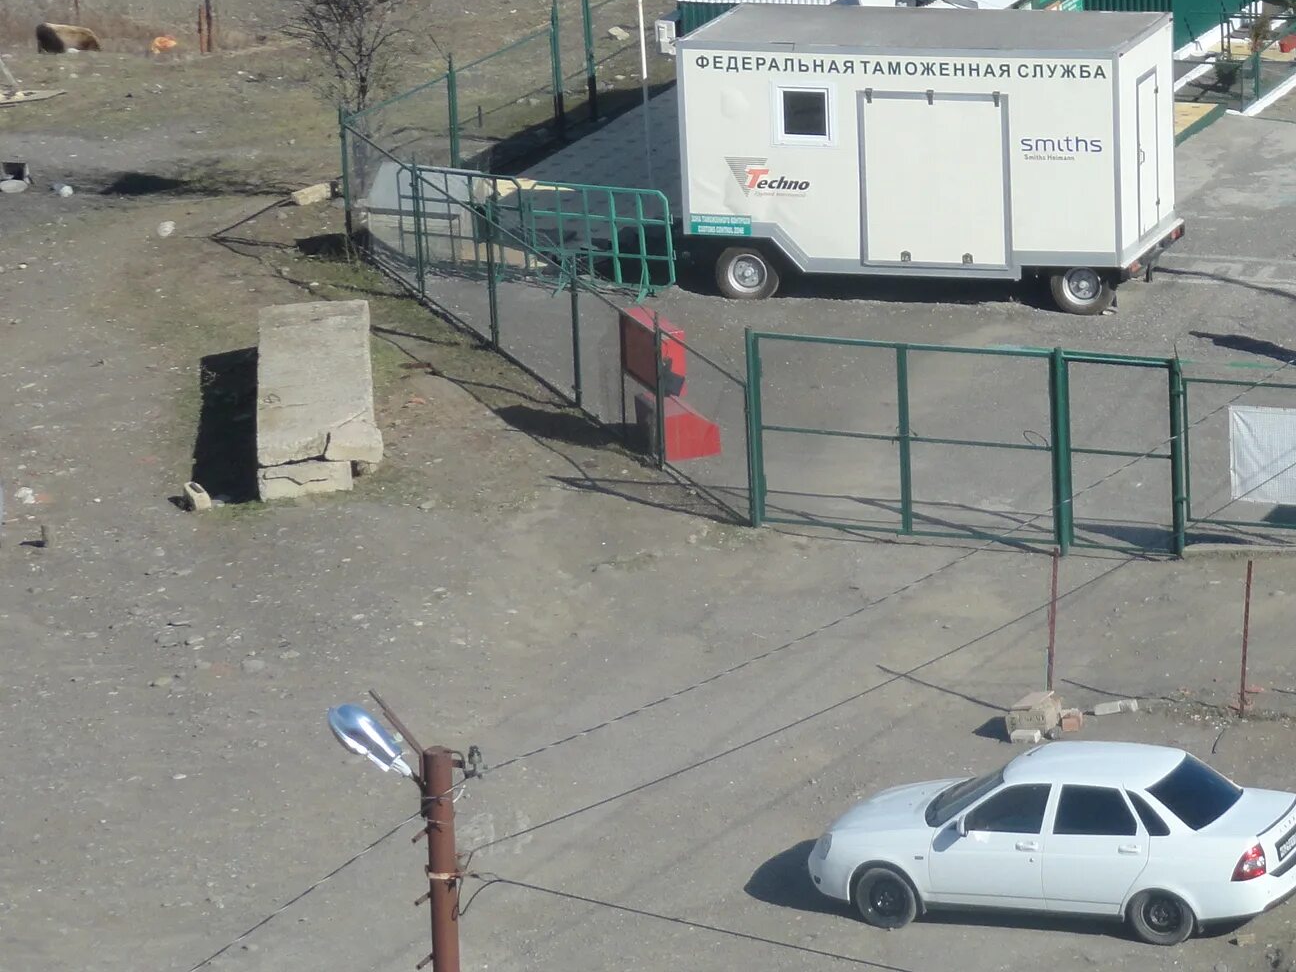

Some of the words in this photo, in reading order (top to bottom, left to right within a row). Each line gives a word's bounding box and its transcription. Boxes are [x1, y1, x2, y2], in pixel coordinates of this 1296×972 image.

[695, 54, 854, 74] ФЕДЕРАЛЬНАЯ
[860, 60, 1011, 78] ТАМОЖЕННАЯ
[1017, 63, 1107, 80] СЛУЖБА
[1020, 136, 1103, 153] smiths
[746, 168, 810, 190] Techno
